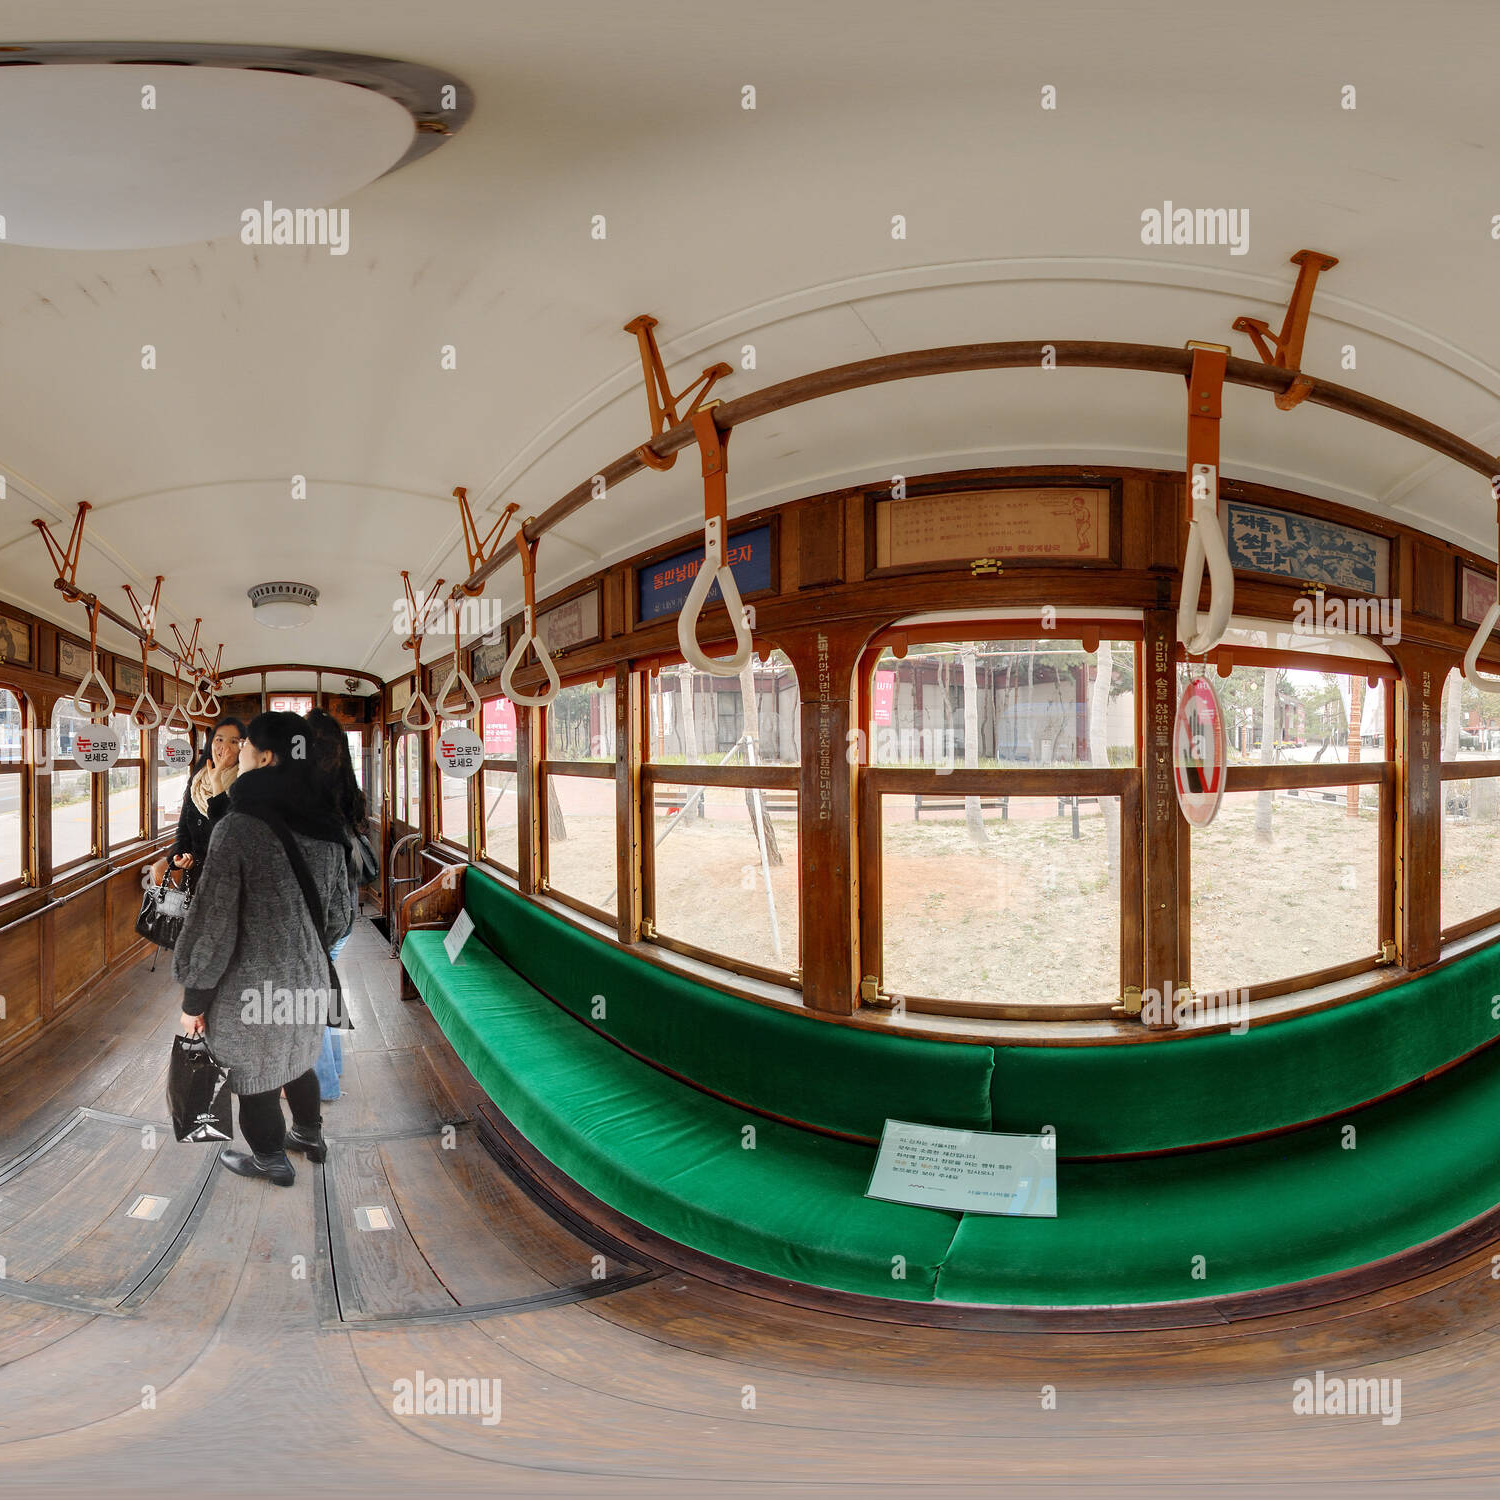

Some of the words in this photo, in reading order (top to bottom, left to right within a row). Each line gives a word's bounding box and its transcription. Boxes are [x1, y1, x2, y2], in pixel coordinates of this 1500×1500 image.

[653, 544, 753, 590] 둘만낳아르자
[76, 736, 117, 753] 눈으로만
[165, 746, 192, 757] 눈으로만
[440, 740, 481, 758] 눈으로만
[84, 753, 109, 763] 보세요
[448, 758, 474, 768] 보세요
